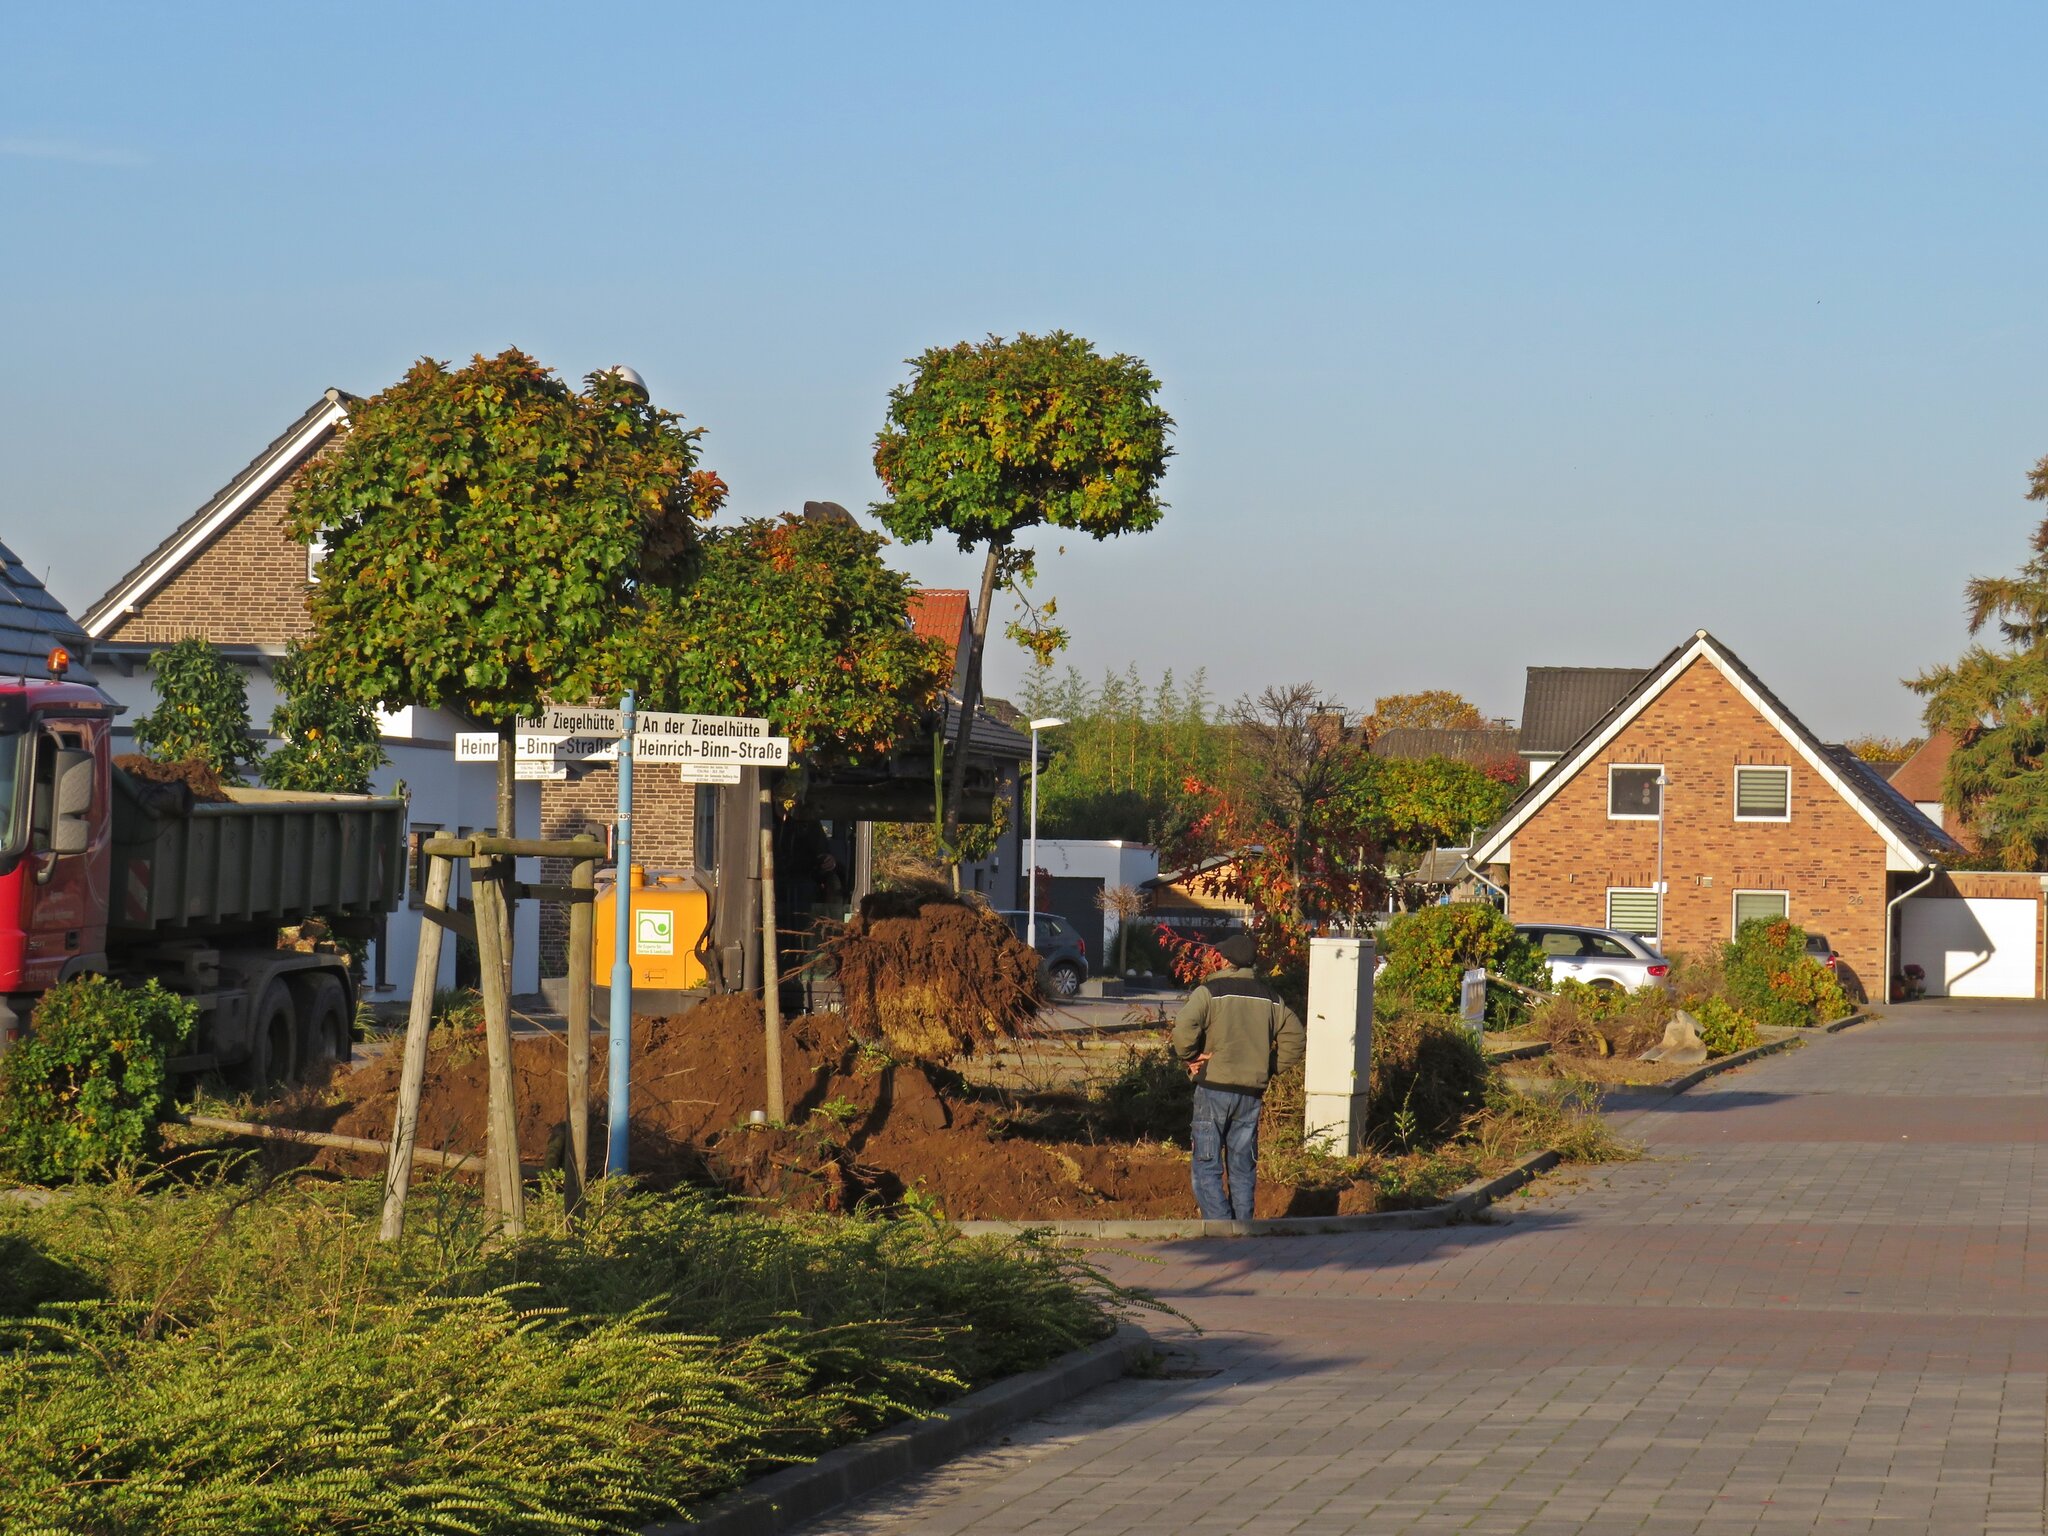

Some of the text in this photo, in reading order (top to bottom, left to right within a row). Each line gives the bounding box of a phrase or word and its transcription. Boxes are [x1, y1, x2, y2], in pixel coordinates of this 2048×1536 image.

[553, 712, 615, 734] Ziegelhütte
[642, 716, 760, 738] An der Ziegelhütte
[639, 739, 782, 759] Heinrich-Binn-Straße
[1848, 895, 1864, 906] 26
